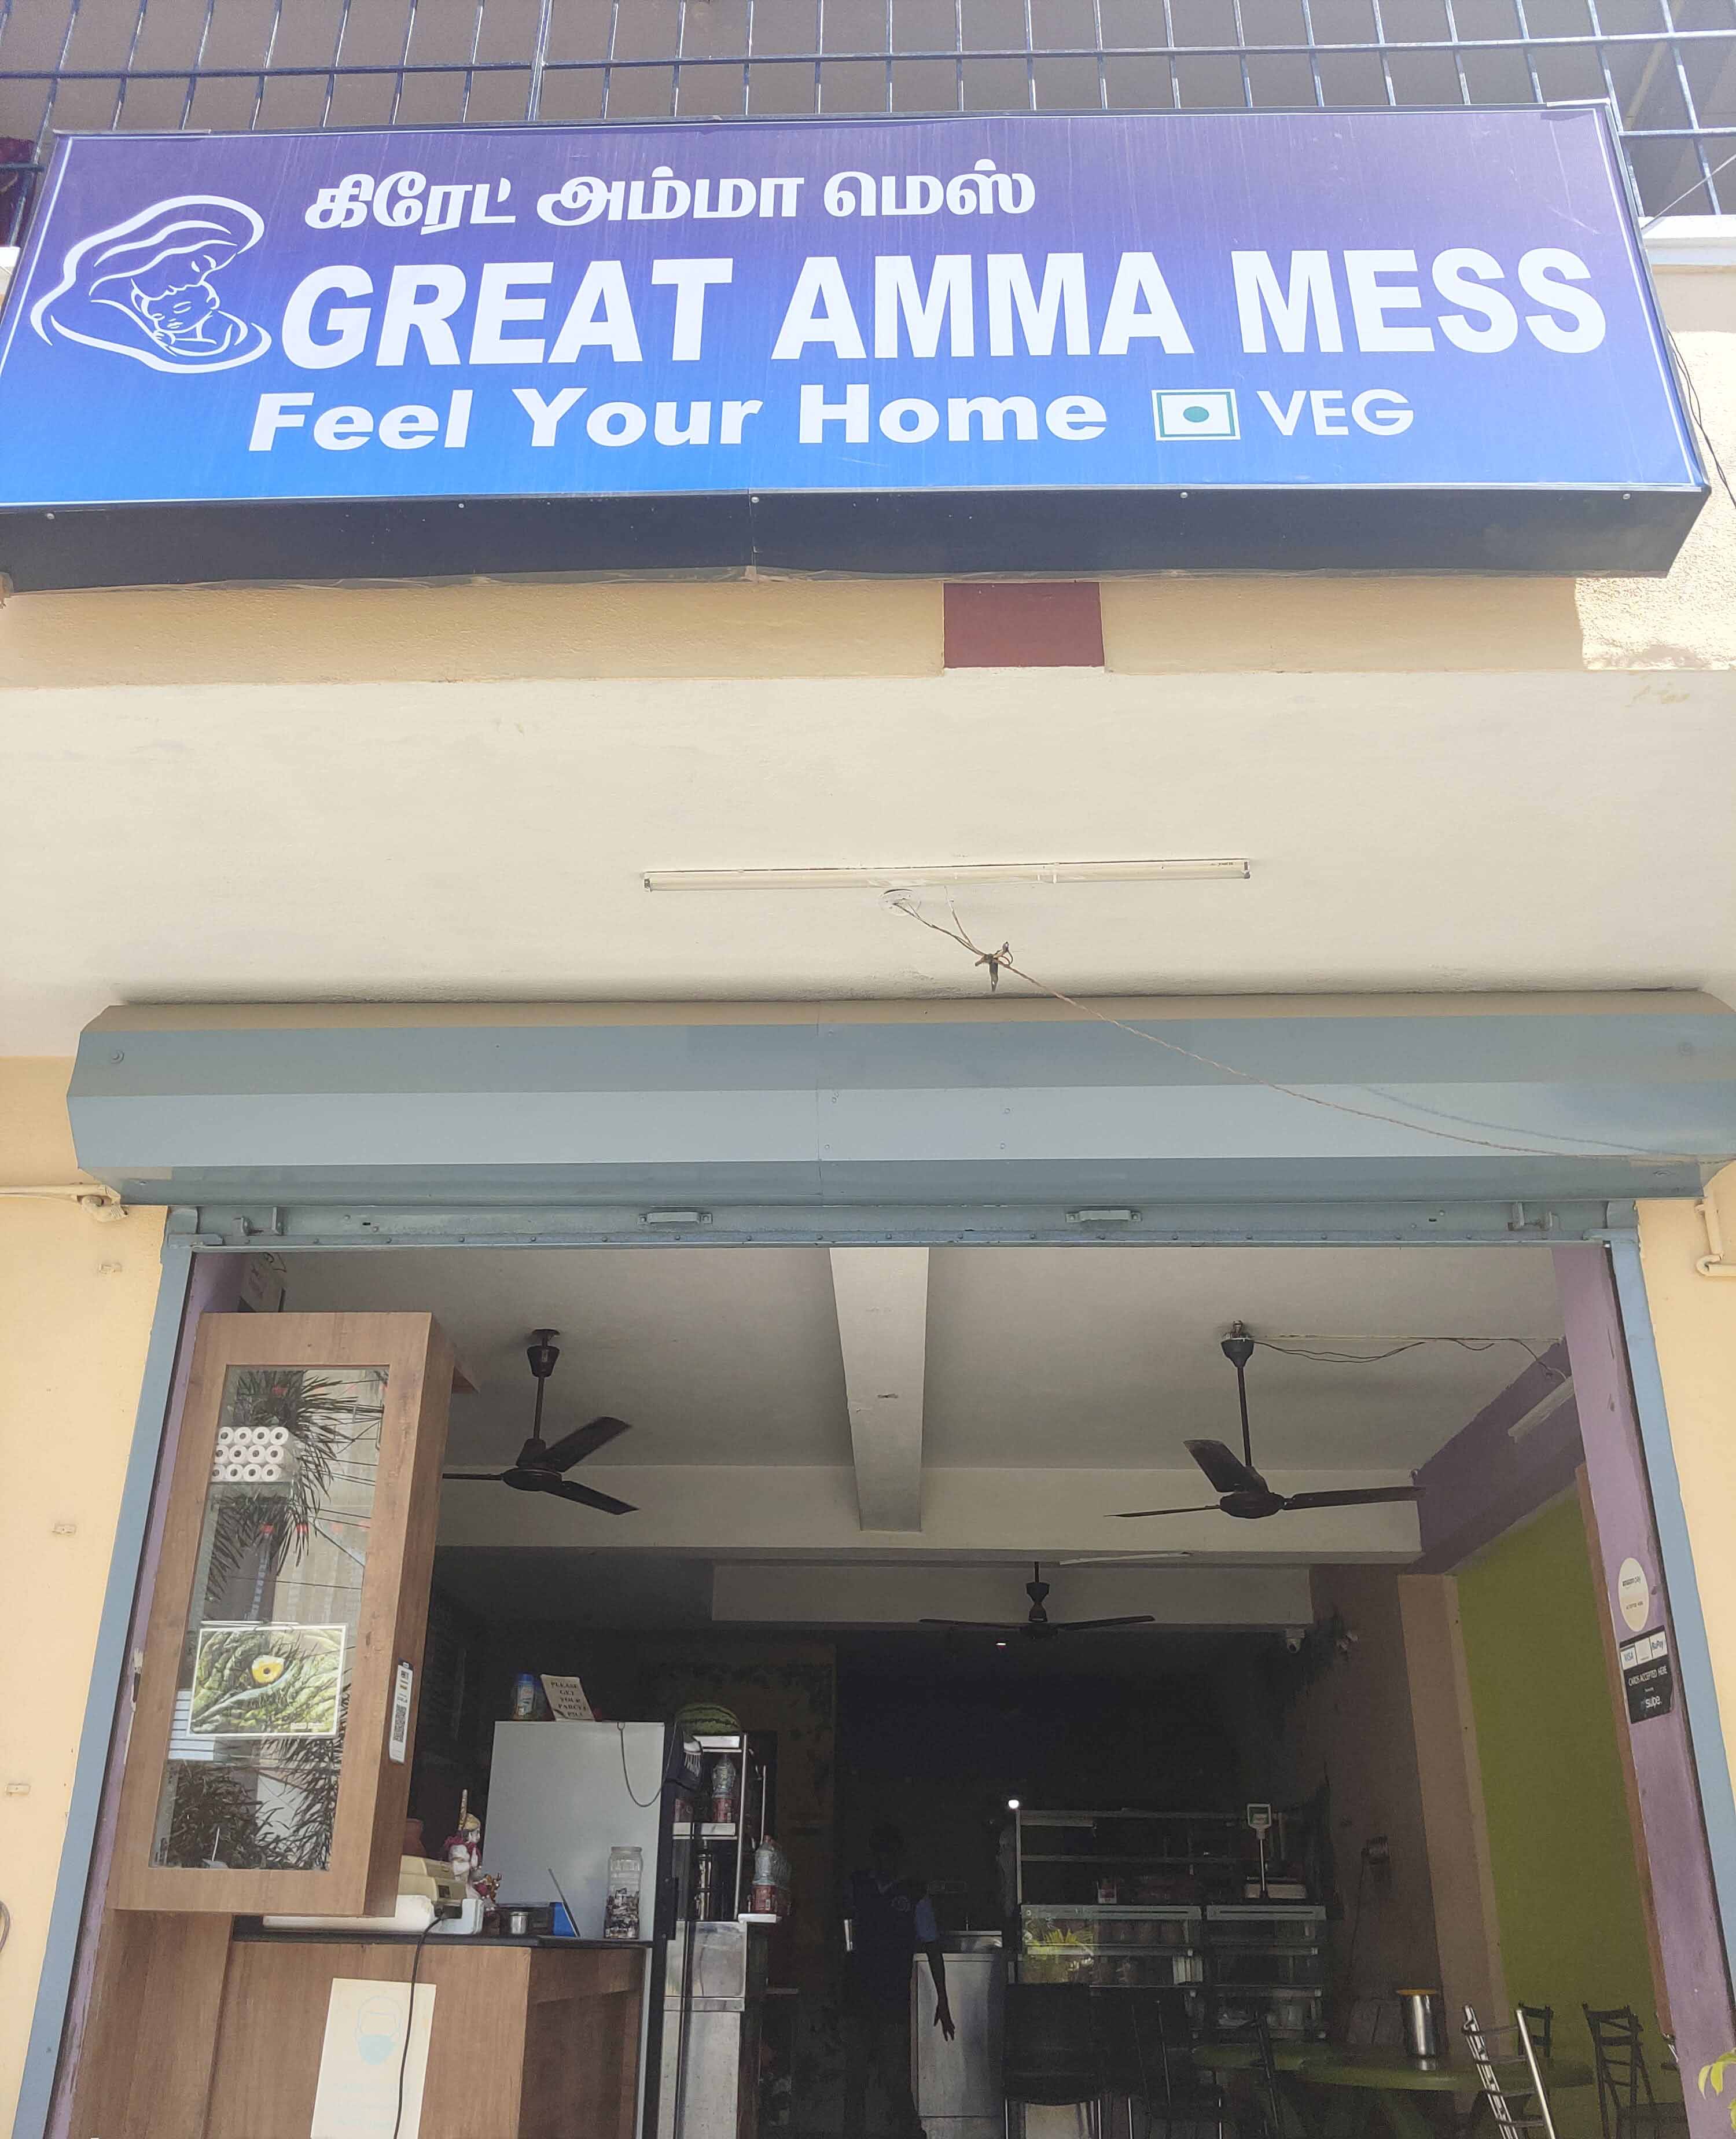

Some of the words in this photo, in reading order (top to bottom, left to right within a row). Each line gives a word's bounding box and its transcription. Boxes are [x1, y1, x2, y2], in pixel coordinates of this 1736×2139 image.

[304, 171, 516, 235] கிரேட்
[536, 166, 804, 226] அம்மா
[823, 159, 1035, 217] மெஸ்
[282, 258, 733, 370] GREAT
[771, 252, 1195, 359] AMMA
[1231, 248, 1606, 354] MESS
[249, 389, 473, 451] Feel
[512, 388, 763, 447] Your
[799, 384, 1107, 443] Home
[1256, 389, 1414, 436] VEG
